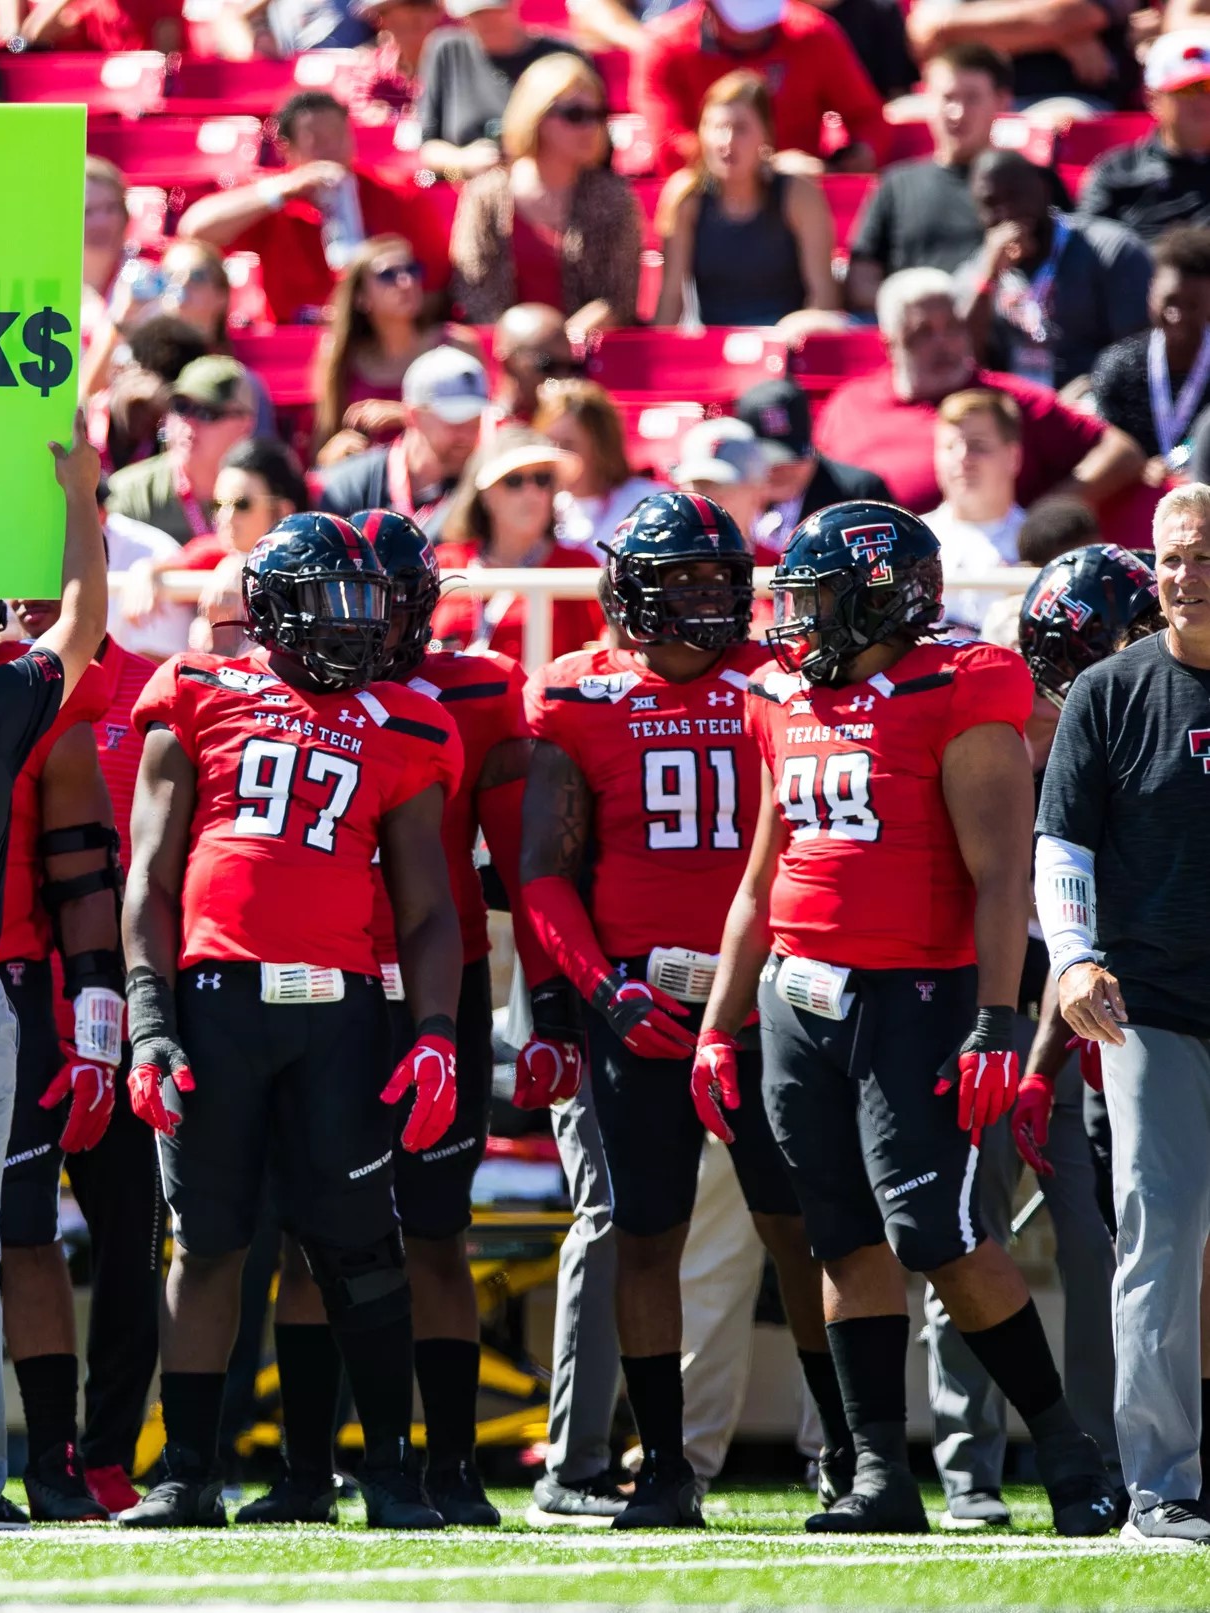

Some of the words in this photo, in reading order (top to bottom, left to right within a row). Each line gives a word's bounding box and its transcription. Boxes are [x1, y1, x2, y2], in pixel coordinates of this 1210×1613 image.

[254, 711, 315, 737] TEXAS
[318, 727, 363, 755] TECH
[628, 719, 691, 739] TEXAS
[695, 718, 743, 735] TECH
[786, 725, 831, 744] TEXAS
[834, 723, 875, 741] TECH
[233, 737, 363, 855] 97
[643, 746, 742, 850] 91
[778, 750, 883, 843] 98
[33, 1143, 51, 1156] UP
[422, 1146, 459, 1163] GUNS
[458, 1137, 476, 1150] UP
[349, 1159, 382, 1180] GUNS
[884, 1179, 919, 1201] GUNS
[917, 1170, 938, 1185] UP
